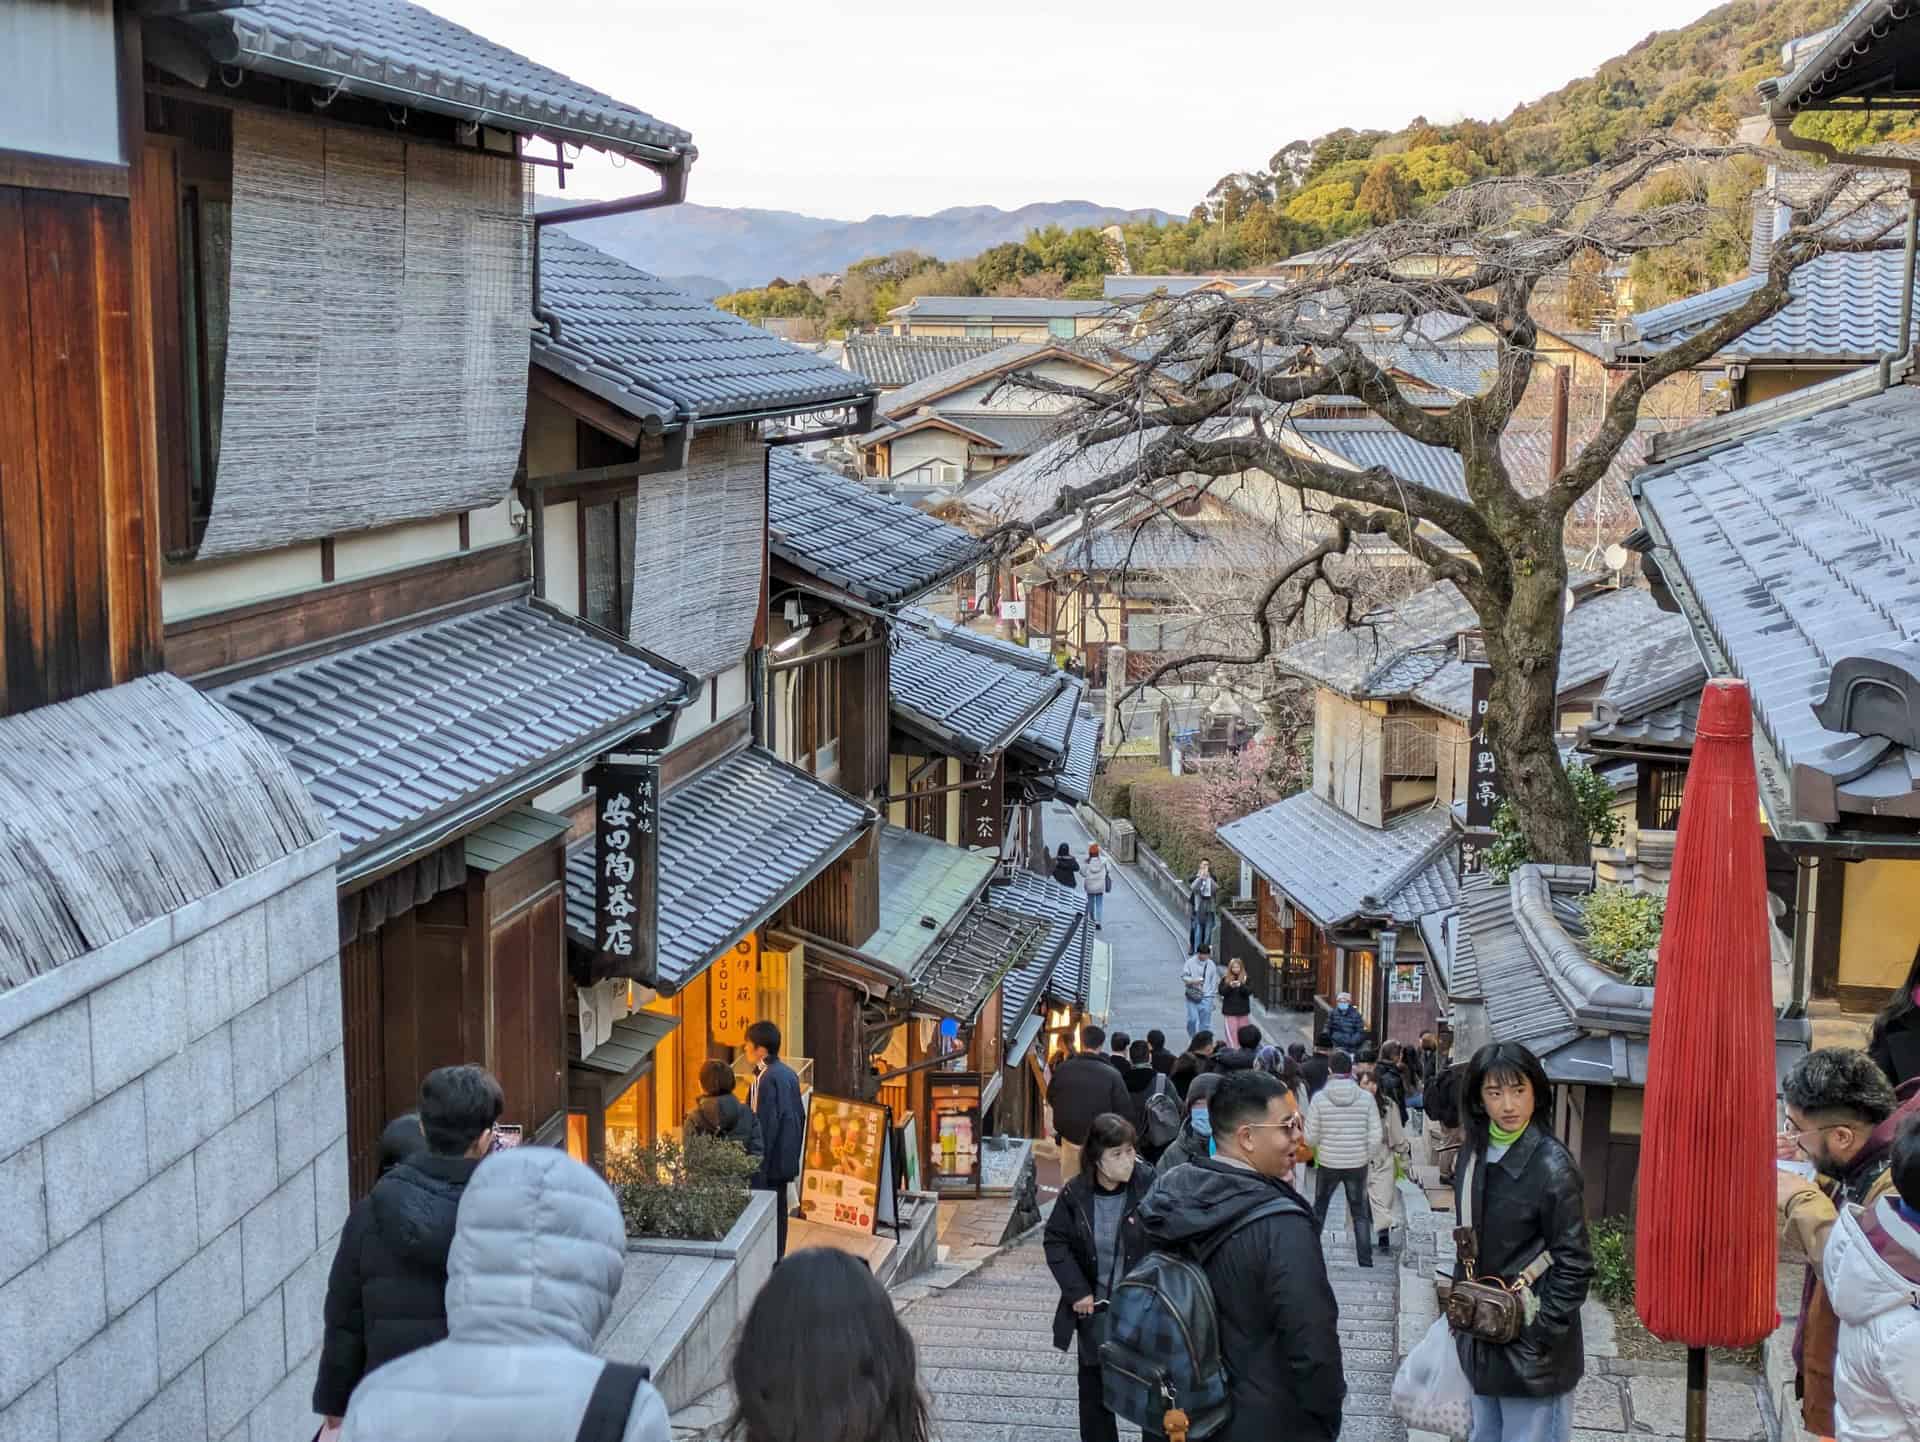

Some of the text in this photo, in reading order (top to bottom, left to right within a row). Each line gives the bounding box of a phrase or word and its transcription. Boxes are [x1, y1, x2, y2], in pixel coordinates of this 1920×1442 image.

[637, 781, 655, 834] 清水焼
[601, 792, 637, 956] 安田陶器店
